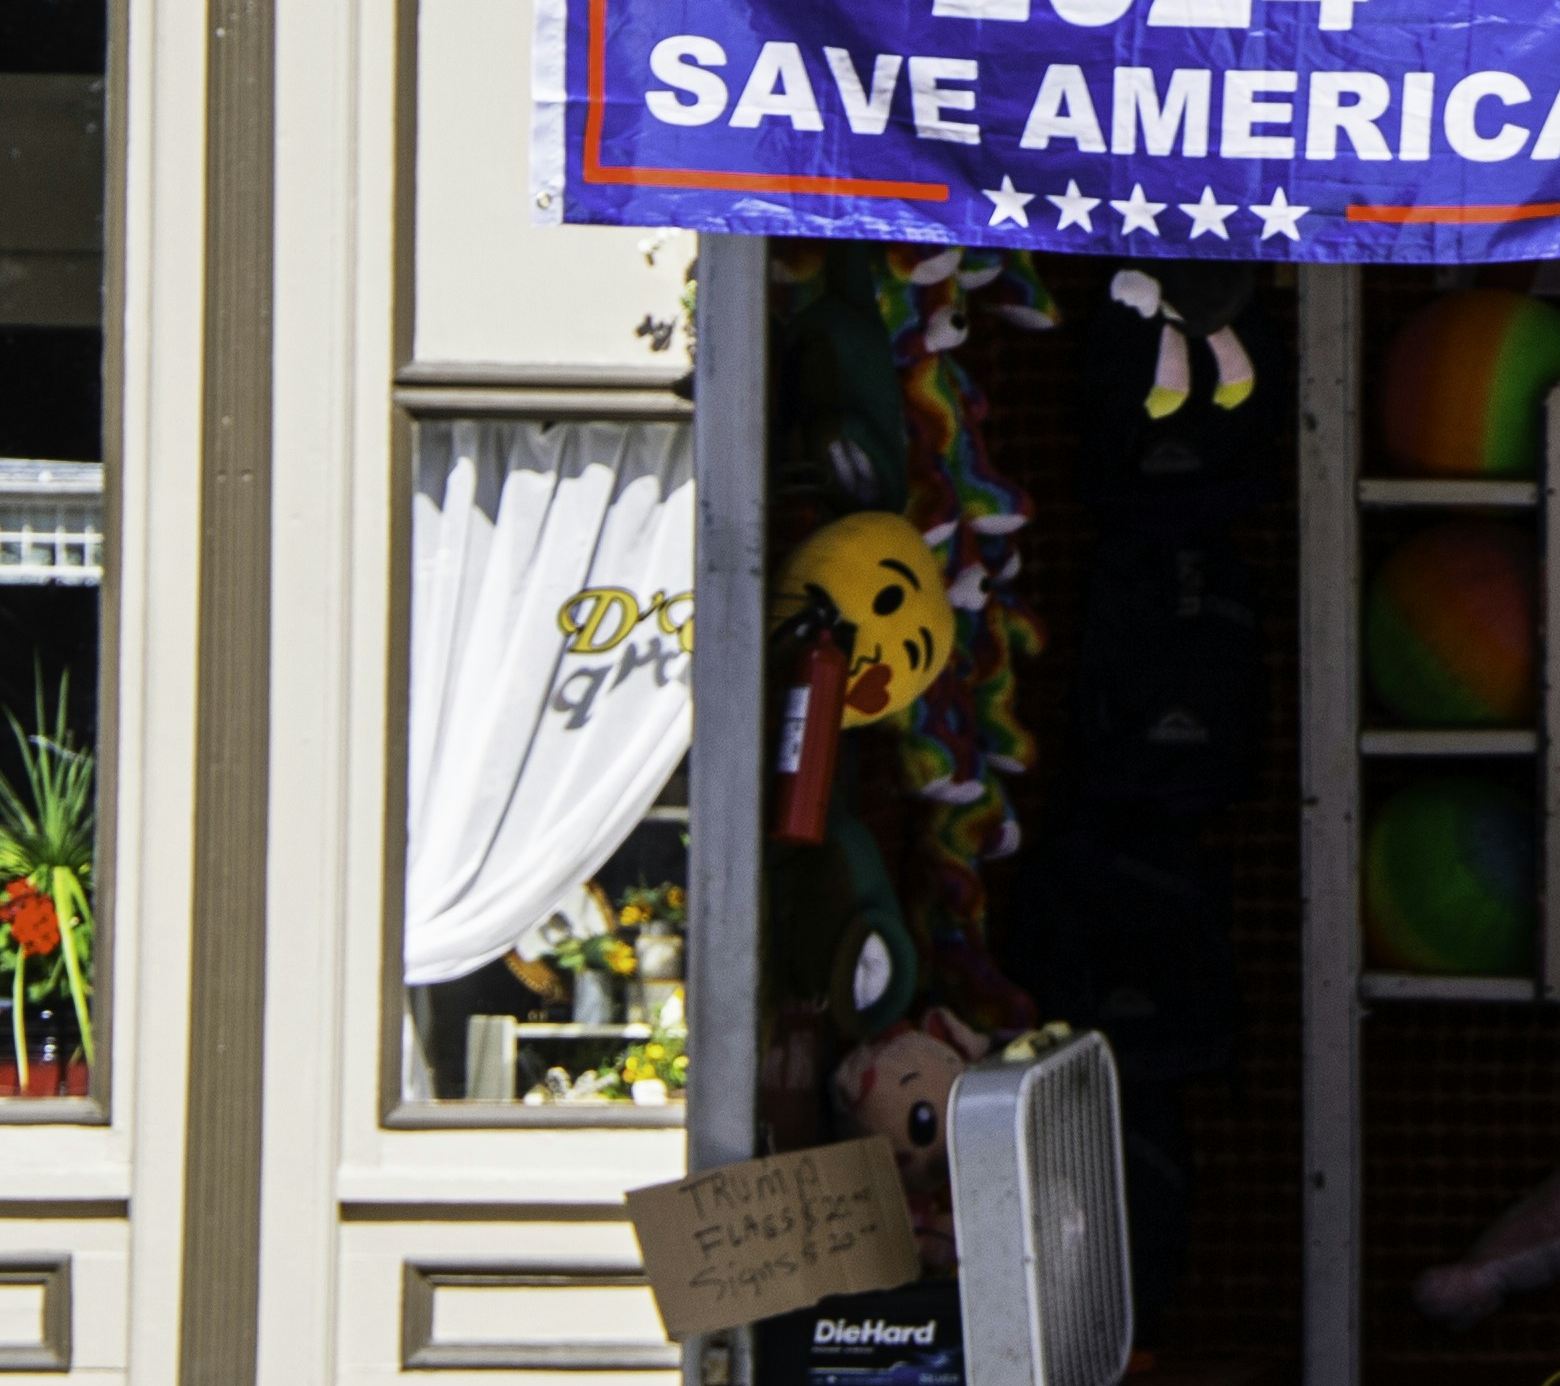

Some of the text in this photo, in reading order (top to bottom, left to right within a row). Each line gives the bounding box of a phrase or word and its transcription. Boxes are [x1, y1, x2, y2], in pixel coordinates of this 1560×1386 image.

[644, 34, 981, 146] SAVE
[680, 1156, 820, 1218] TRUMP
[812, 1317, 938, 1346] DieHard
